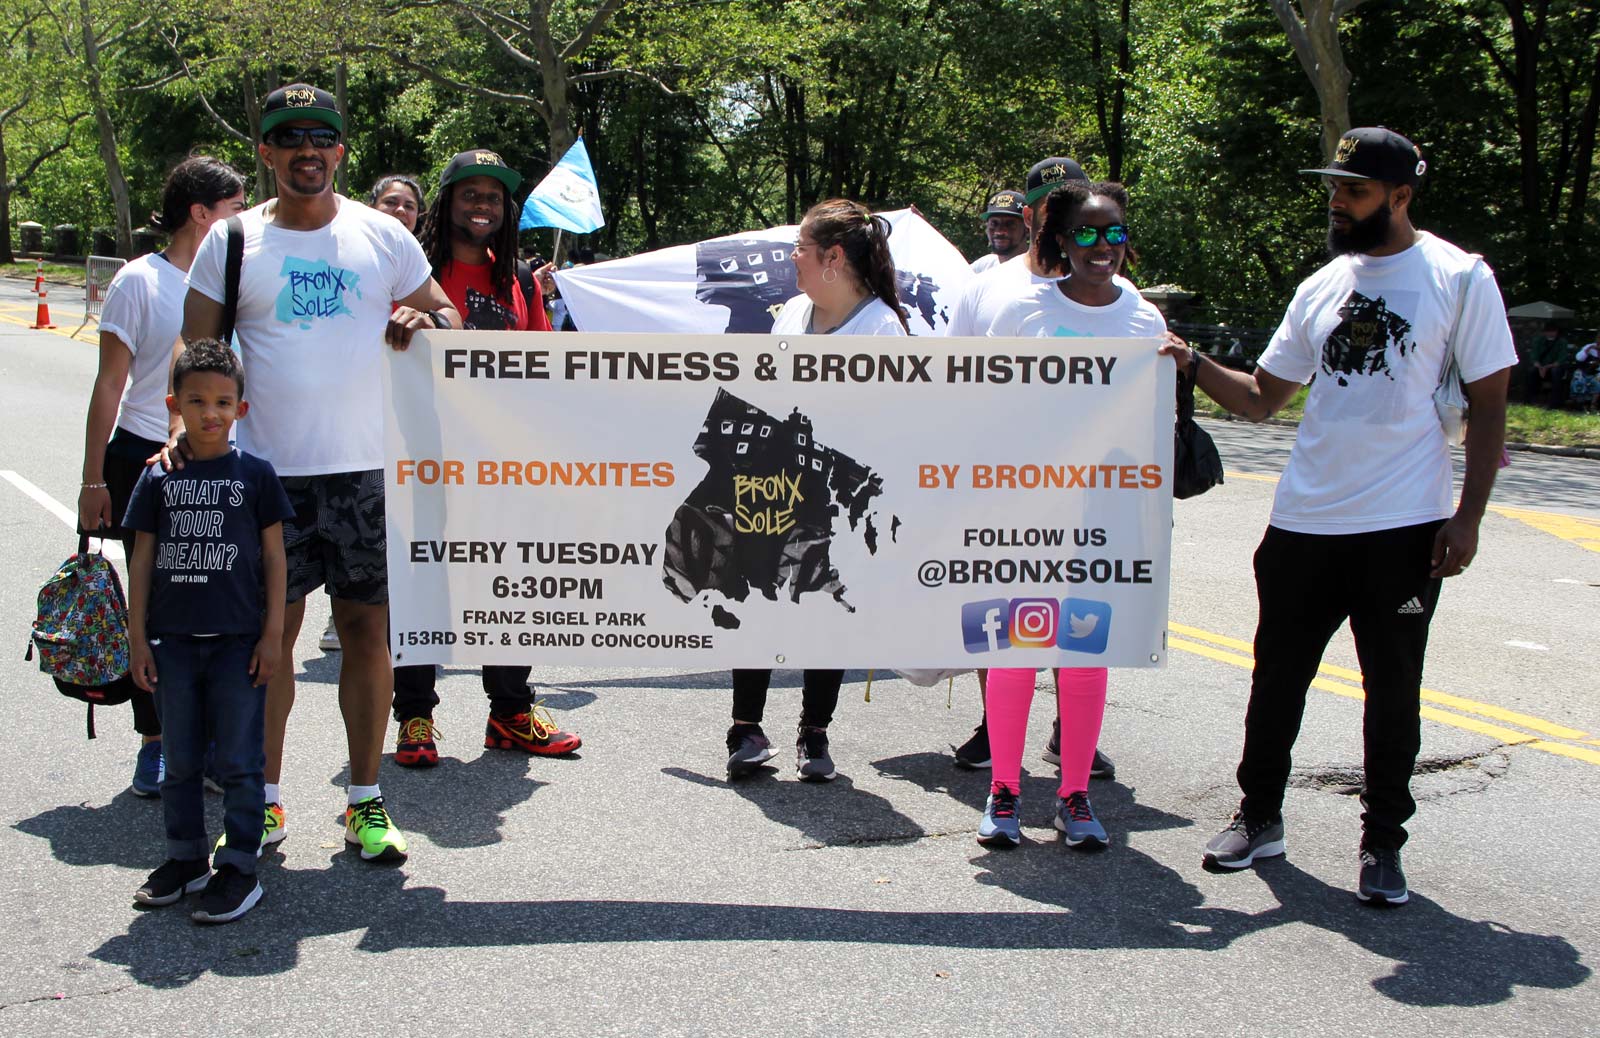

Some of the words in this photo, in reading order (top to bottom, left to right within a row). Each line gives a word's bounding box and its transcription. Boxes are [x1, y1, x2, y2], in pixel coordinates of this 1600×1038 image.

[285, 88, 317, 102] BRONX
[289, 265, 347, 297] BRONX
[292, 294, 340, 318] SOLE
[445, 350, 550, 380] FREE
[565, 352, 740, 382] FITNESS
[755, 354, 778, 381] &
[793, 354, 932, 383] BRONX
[947, 356, 1117, 385] HISTORY
[397, 459, 465, 485] FOR
[478, 461, 676, 487] BRONXITES
[919, 465, 960, 488] BY
[972, 465, 1162, 489] BRONXITES
[163, 479, 245, 507] WHAT'S
[733, 468, 804, 509] BRONX
[169, 510, 224, 537] YOUR
[735, 504, 796, 535] SOLE
[964, 529, 1064, 547] FOLLOW
[1074, 529, 1107, 547] US
[156, 543, 239, 571] DREAM?
[411, 541, 507, 563] EVERY
[517, 542, 658, 565] TUESDAY
[171, 575, 188, 583] ADOPT
[194, 575, 208, 583] DINO
[918, 559, 1152, 588] @BRONXSOLE
[493, 576, 603, 600] 6:30PM
[464, 611, 526, 625] FRANZ
[533, 611, 589, 626] SIGEL
[596, 612, 646, 627] PARK
[398, 631, 458, 646] 153RD
[464, 632, 494, 646] ST.
[501, 633, 512, 646] &
[518, 633, 584, 647] GRAND
[591, 634, 714, 649] CONCOURSE
